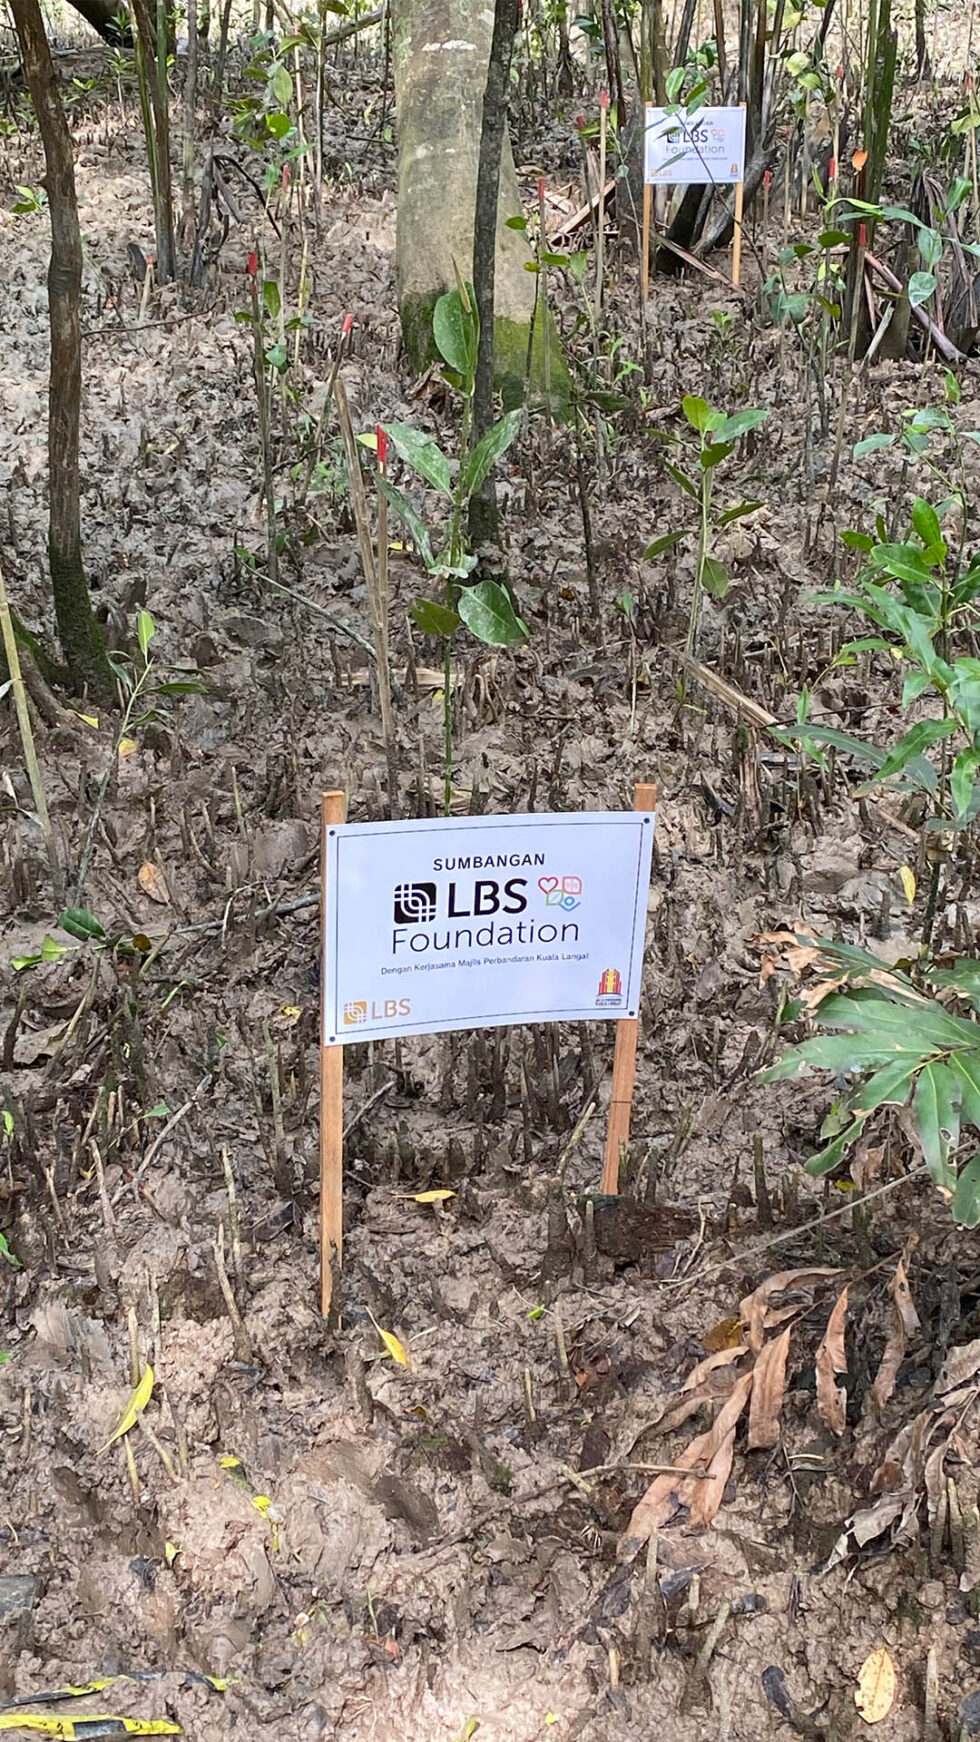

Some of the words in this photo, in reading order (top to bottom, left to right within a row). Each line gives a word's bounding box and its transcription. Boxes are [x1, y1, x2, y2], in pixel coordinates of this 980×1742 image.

[683, 129, 708, 143] LBS
[433, 853, 545, 871] SUMBANGAN
[448, 878, 528, 918] LBS
[393, 919, 579, 954] Foundation
[381, 965, 412, 976] Dengan
[414, 961, 456, 972] Kerjasama
[458, 958, 481, 968] Majlis
[483, 955, 535, 965] Perbandaran
[536, 953, 560, 962] Kuala
[562, 953, 590, 961] Langat
[371, 998, 411, 1020] LBS
